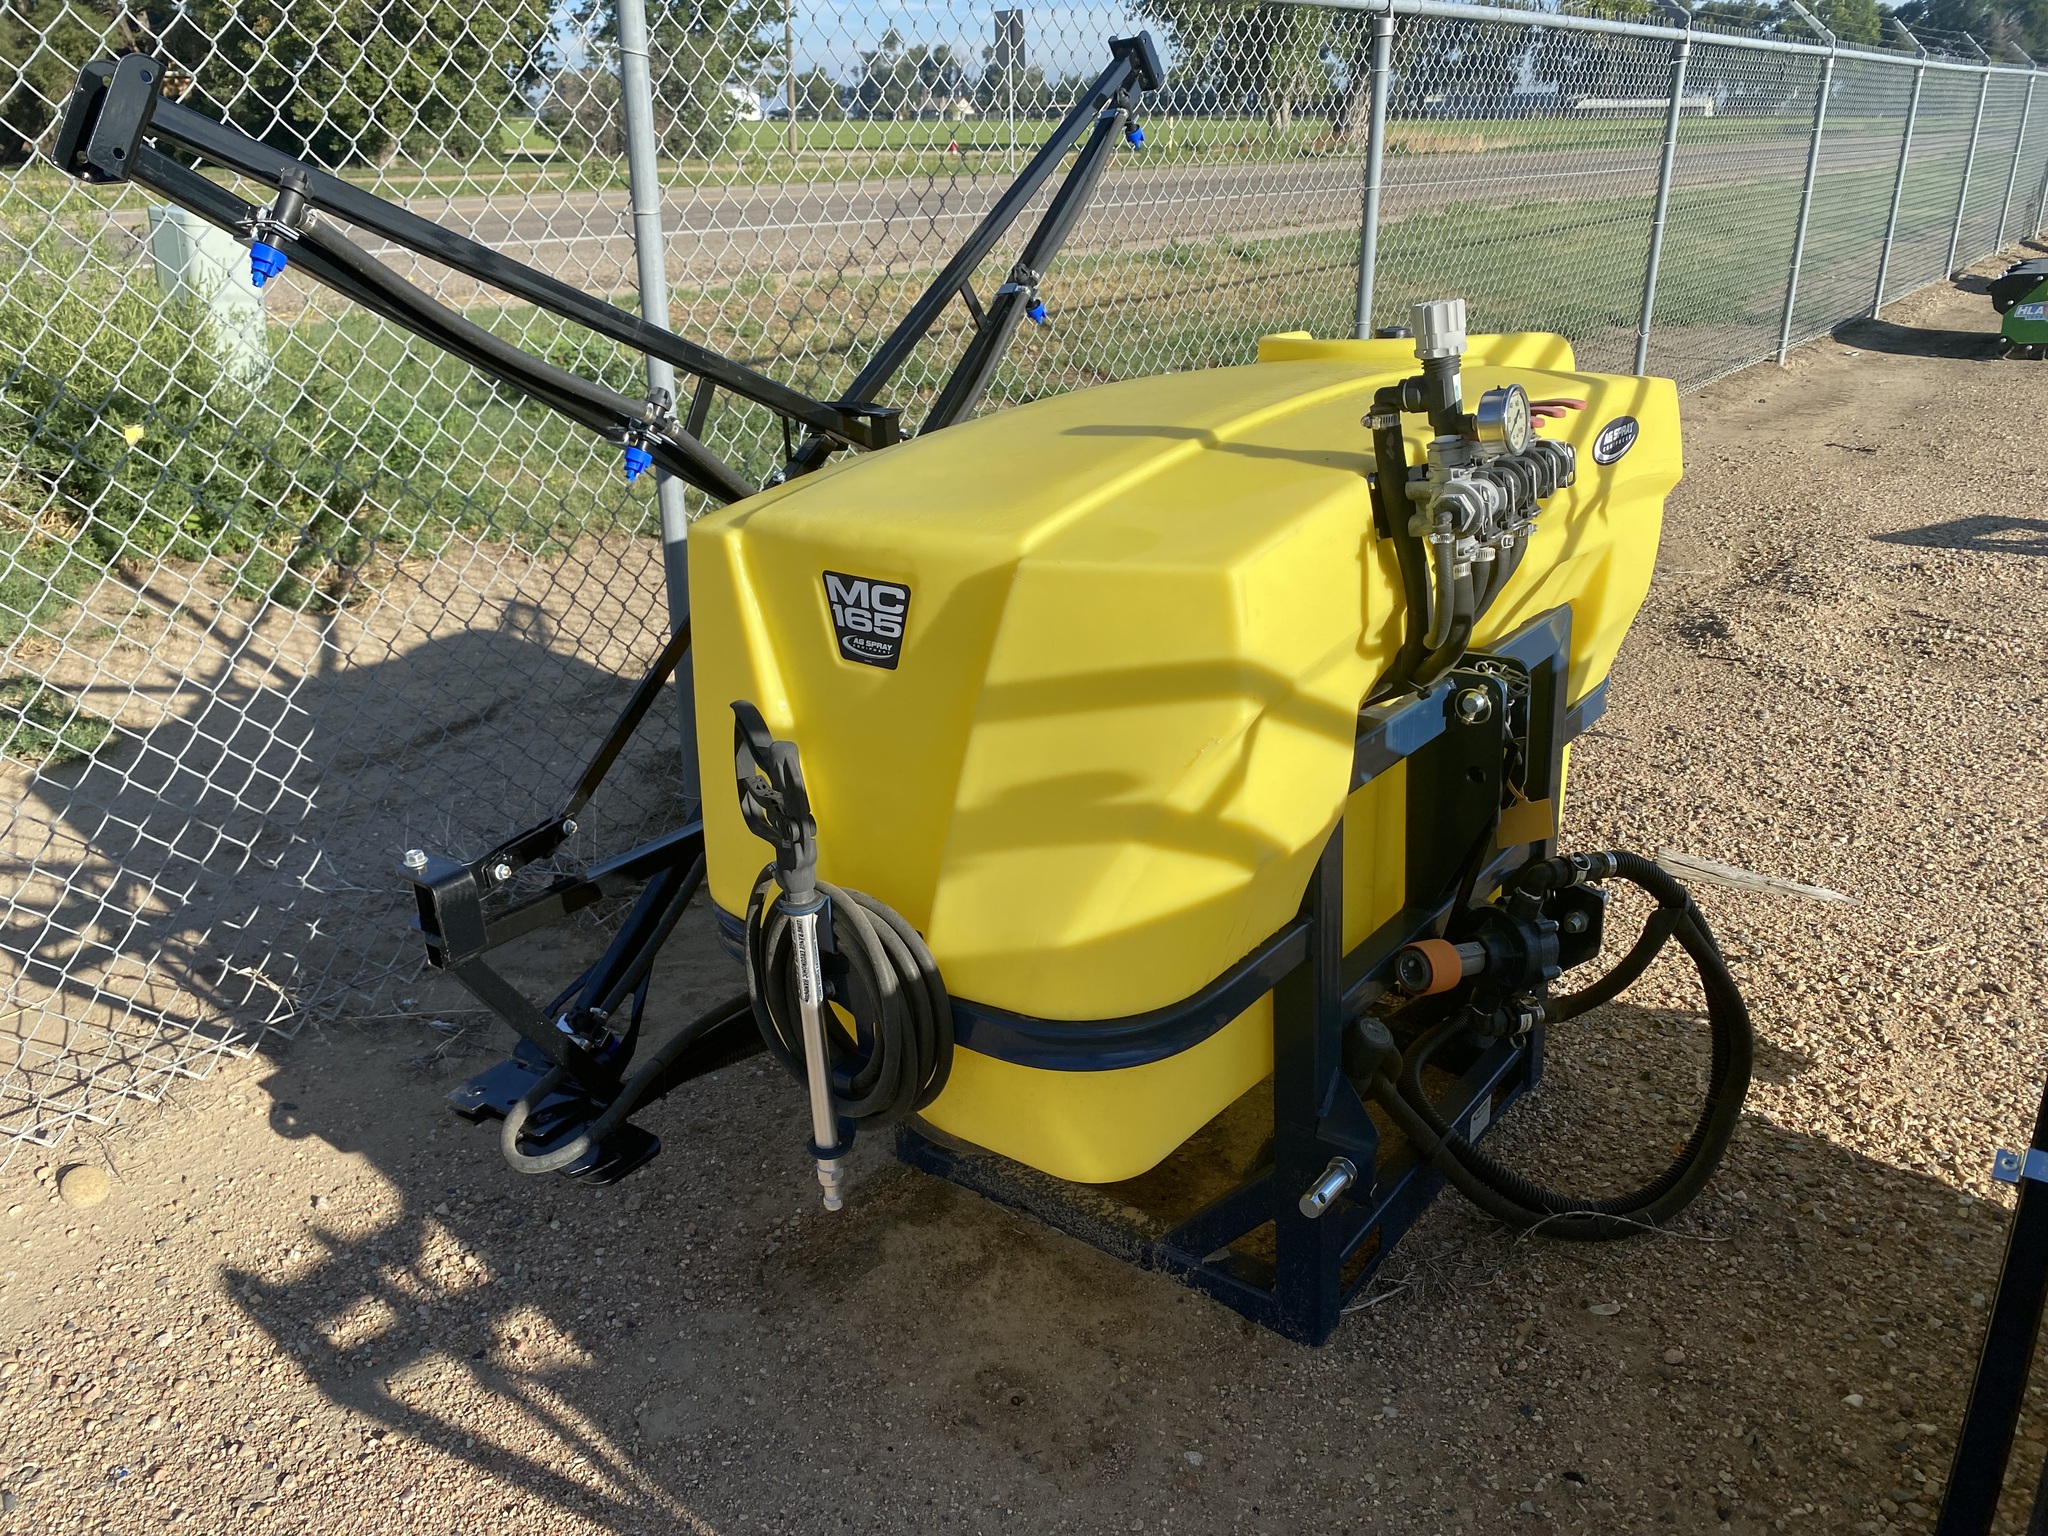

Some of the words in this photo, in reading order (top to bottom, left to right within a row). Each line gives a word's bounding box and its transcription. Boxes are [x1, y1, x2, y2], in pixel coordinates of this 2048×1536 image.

[2016, 305, 2044, 315] HLA
[1603, 430, 1614, 445] AG
[1613, 421, 1635, 441] SPRAY
[825, 574, 906, 614] MC
[832, 603, 902, 638] 165
[853, 637, 865, 646] AG
[865, 640, 893, 651] SPRAY
[798, 933, 806, 950] RANGE
[799, 950, 809, 979] ERGONOMIC
